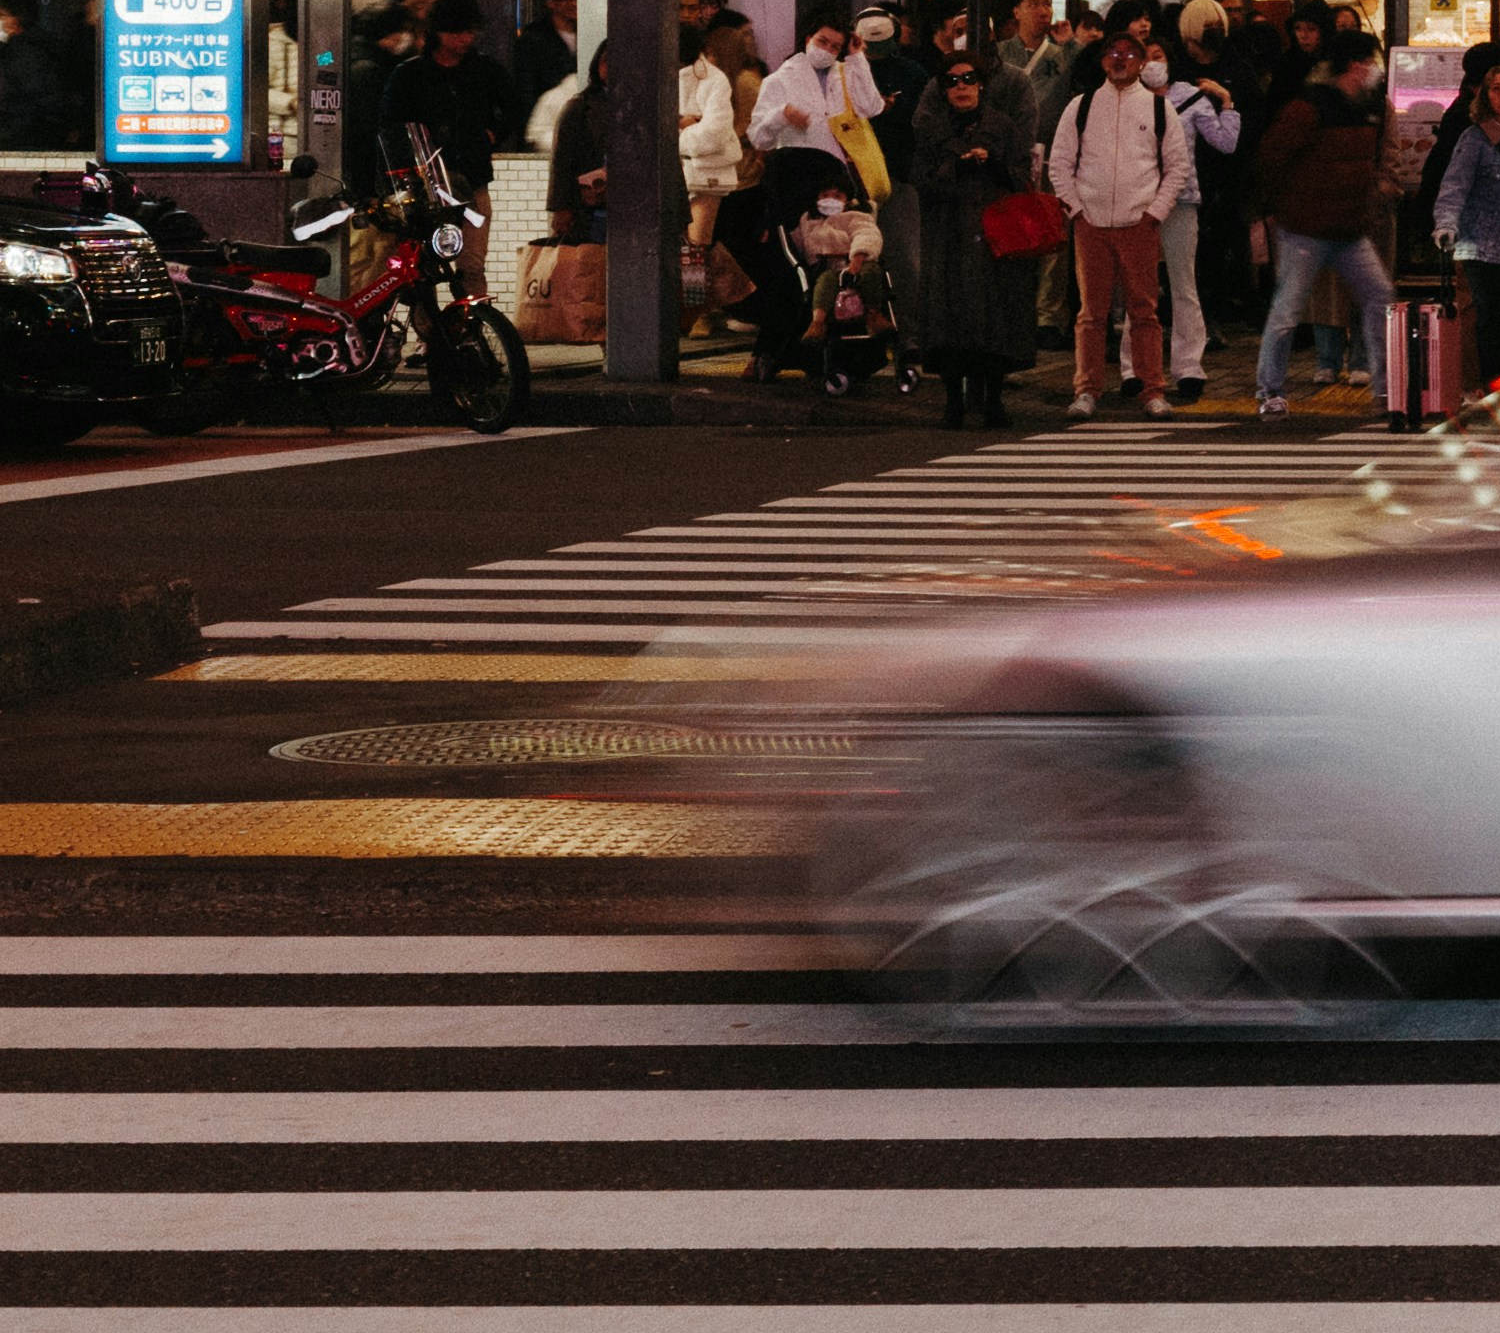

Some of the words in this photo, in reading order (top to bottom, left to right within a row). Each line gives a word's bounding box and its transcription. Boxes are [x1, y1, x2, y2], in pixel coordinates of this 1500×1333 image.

[118, 49, 228, 69] SUBNADE
[310, 89, 341, 110] NERO
[353, 274, 399, 310] HONDA
[526, 279, 551, 299] GU
